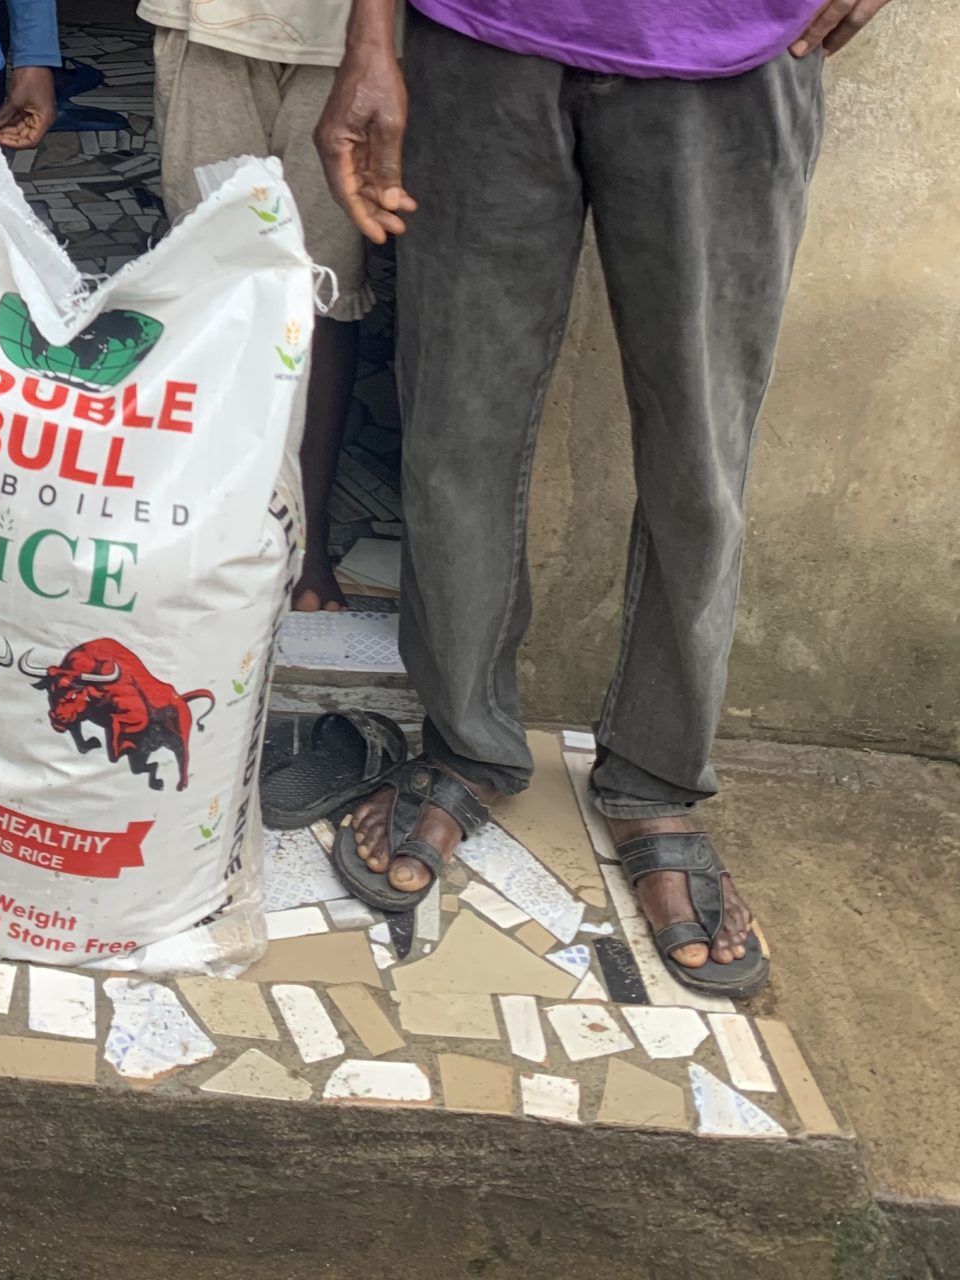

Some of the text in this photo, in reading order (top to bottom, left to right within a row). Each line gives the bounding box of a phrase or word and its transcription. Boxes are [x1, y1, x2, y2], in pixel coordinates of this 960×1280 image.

[18, 846, 65, 869] RICE
[7, 922, 76, 953] Stone
[85, 938, 137, 954] Free
